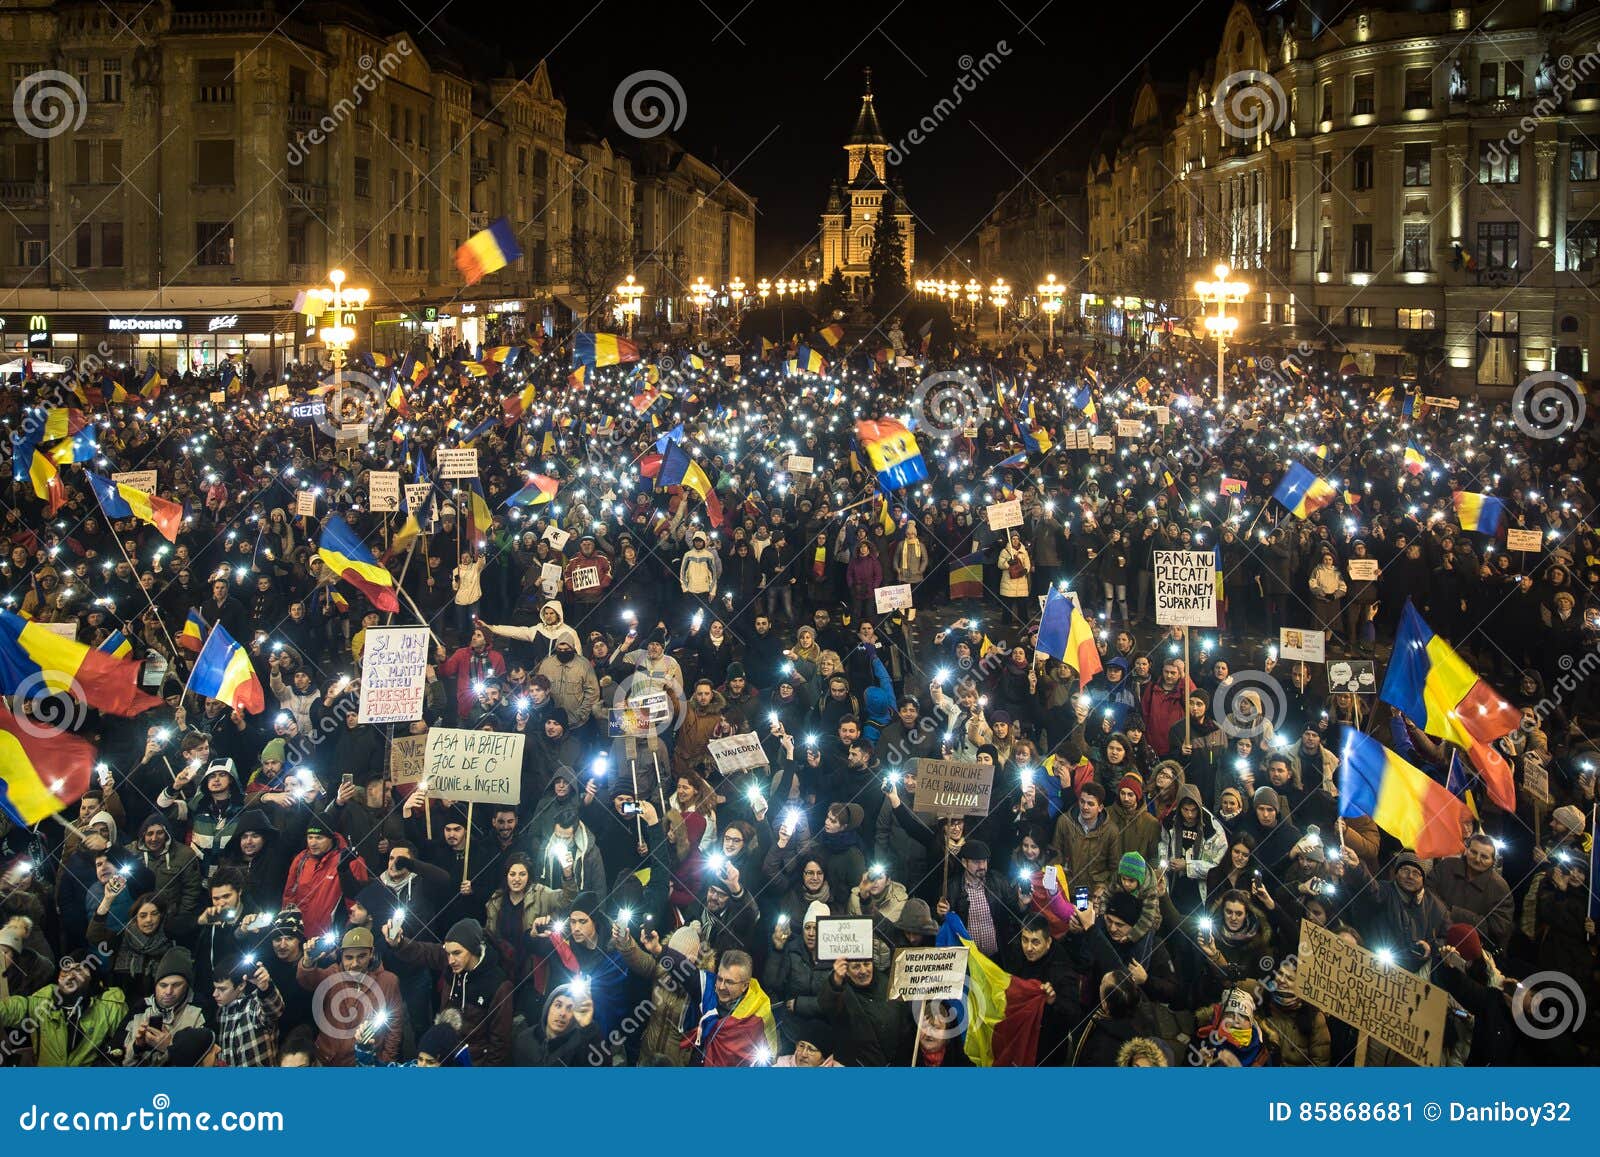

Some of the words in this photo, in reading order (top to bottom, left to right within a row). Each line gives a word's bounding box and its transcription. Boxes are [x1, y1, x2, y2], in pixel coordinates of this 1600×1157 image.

[1197, 554, 1214, 567] NU
[462, 757, 479, 769] DE
[933, 792, 979, 806] LUMINA
[906, 953, 924, 961] VREM
[924, 952, 956, 961] PROGRAM
[904, 965, 914, 973] DE
[910, 976, 920, 984] NU
